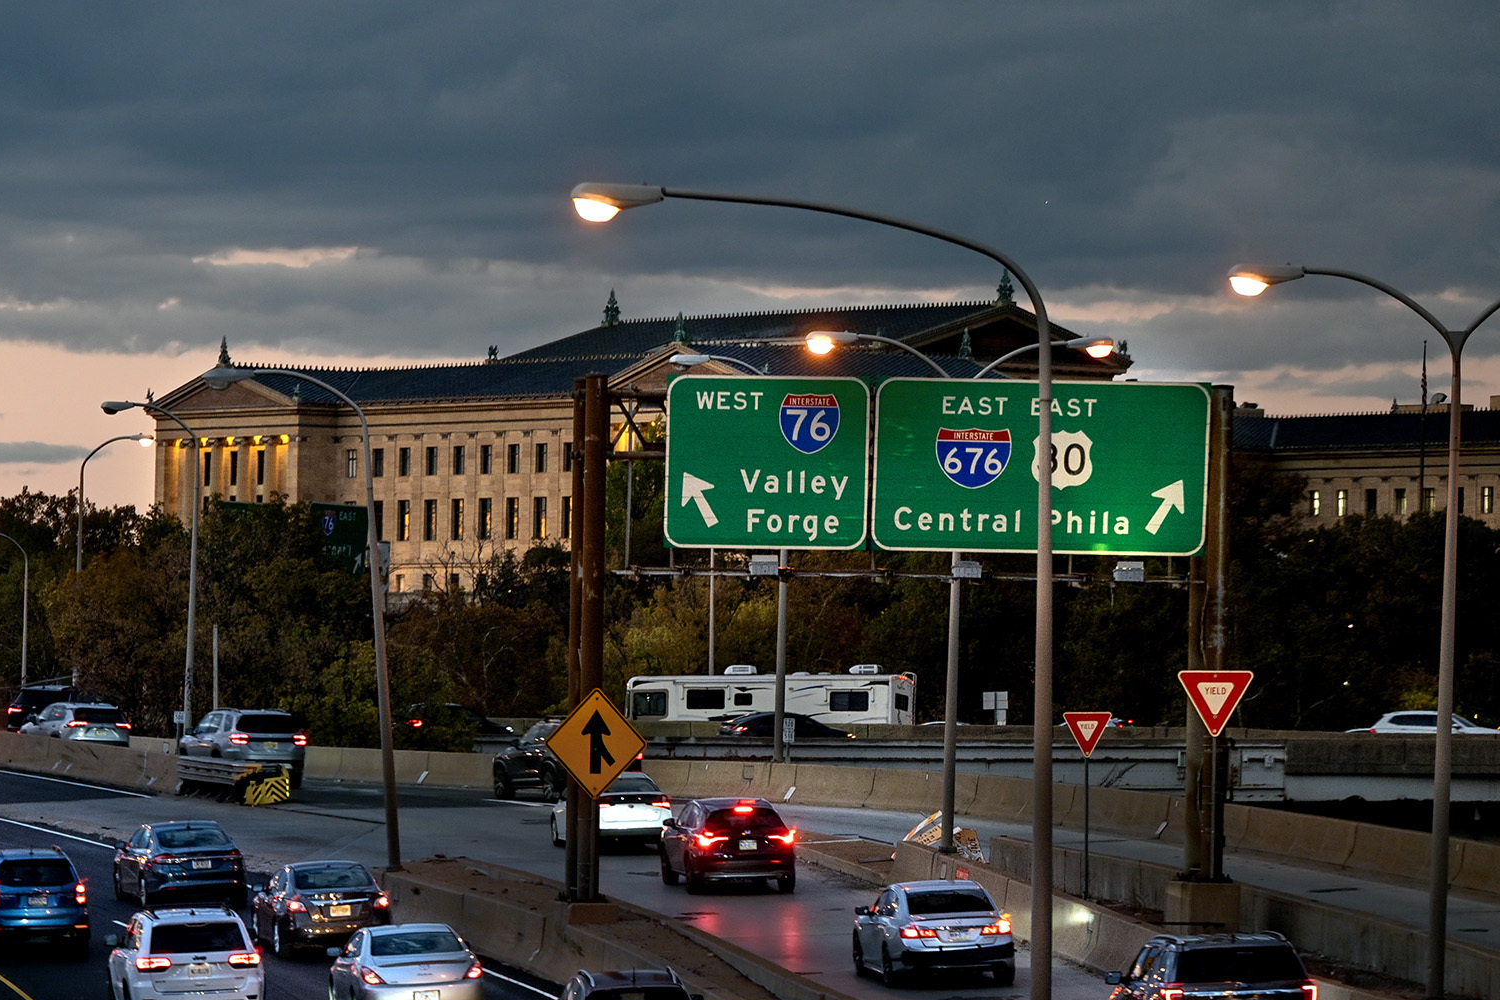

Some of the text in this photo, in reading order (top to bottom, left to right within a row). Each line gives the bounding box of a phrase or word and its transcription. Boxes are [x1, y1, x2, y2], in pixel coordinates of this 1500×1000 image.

[696, 391, 764, 411] WEST
[789, 397, 830, 406] INTERSTATE
[942, 396, 1098, 417] EAST EAST
[786, 409, 831, 442] 76
[953, 431, 994, 441] INTERSTATE
[944, 446, 1002, 476] 676
[740, 469, 849, 501] Valley
[324, 517, 334, 531] 76
[339, 511, 357, 521] EAST
[747, 509, 840, 542] Forge
[893, 506, 1021, 533] Central
[1204, 686, 1227, 696] YIELD
[1080, 722, 1095, 730] YIELD
